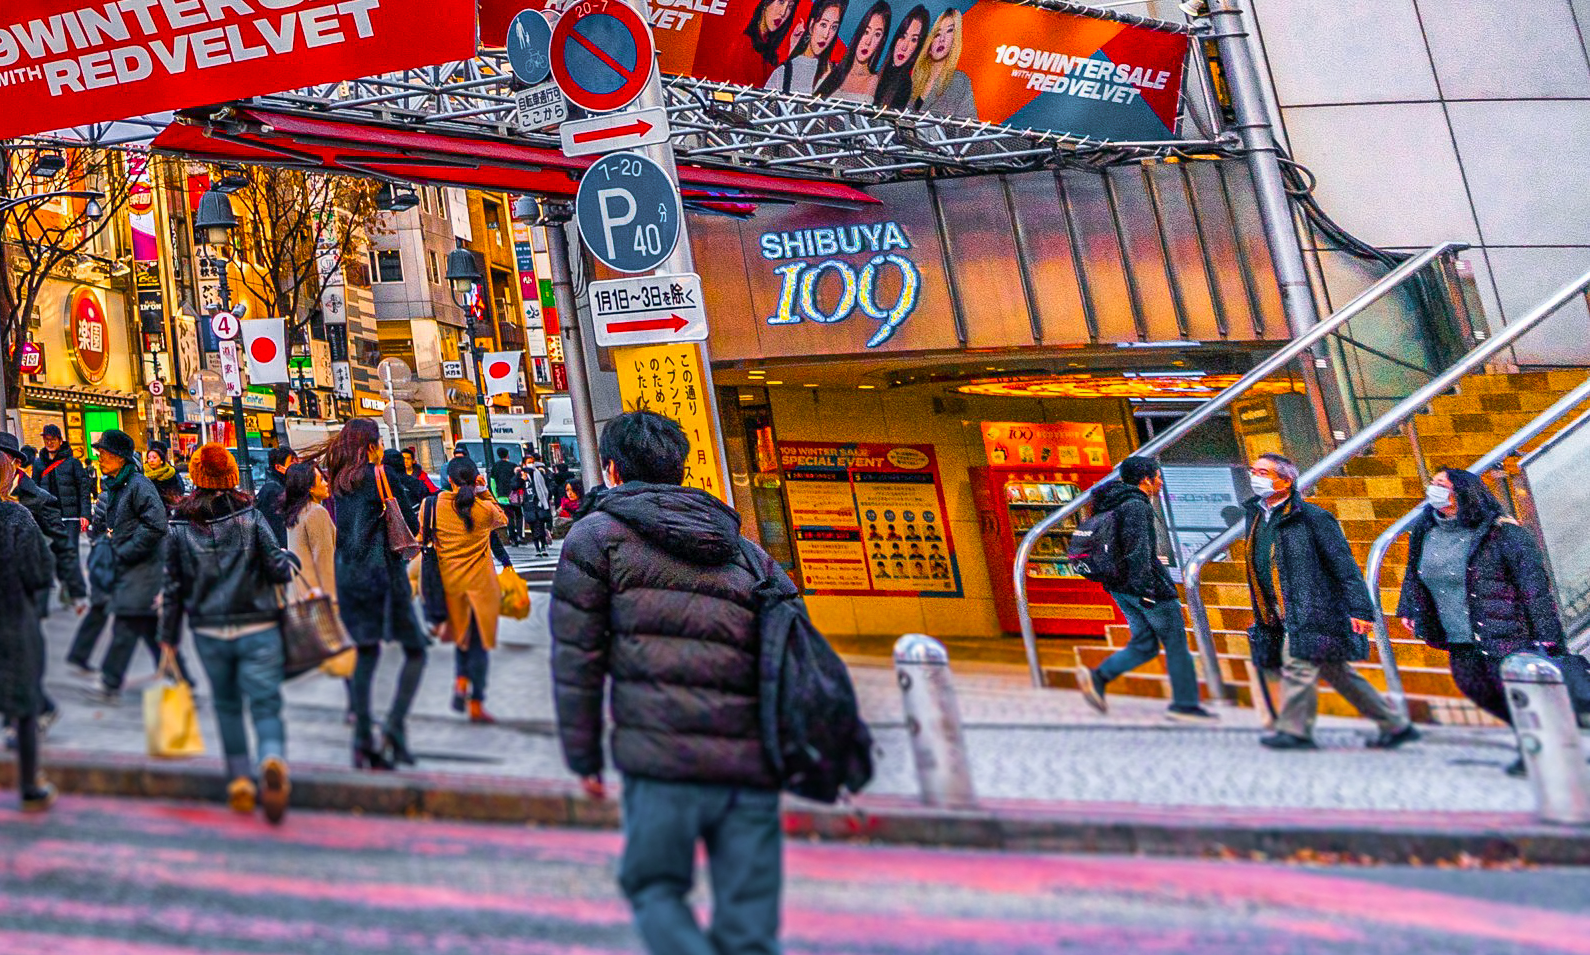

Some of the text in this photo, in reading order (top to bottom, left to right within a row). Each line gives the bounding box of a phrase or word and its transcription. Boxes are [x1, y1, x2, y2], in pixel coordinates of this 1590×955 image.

[574, 0, 610, 19] 20-7
[1010, 68, 1033, 80] WITH
[521, 106, 565, 127] ここから
[598, 158, 642, 181] 7-20
[597, 187, 638, 260] P
[633, 223, 662, 257] 40
[760, 221, 911, 260] SHIBUYA
[766, 253, 919, 348] 109
[78, 318, 103, 353] 楽園
[217, 316, 231, 335] 4
[152, 382, 161, 394] 5
[780, 447, 798, 455] 109
[798, 447, 838, 456] WINTER
[781, 456, 835, 466] SPECIAL
[837, 457, 885, 468] EVENT
